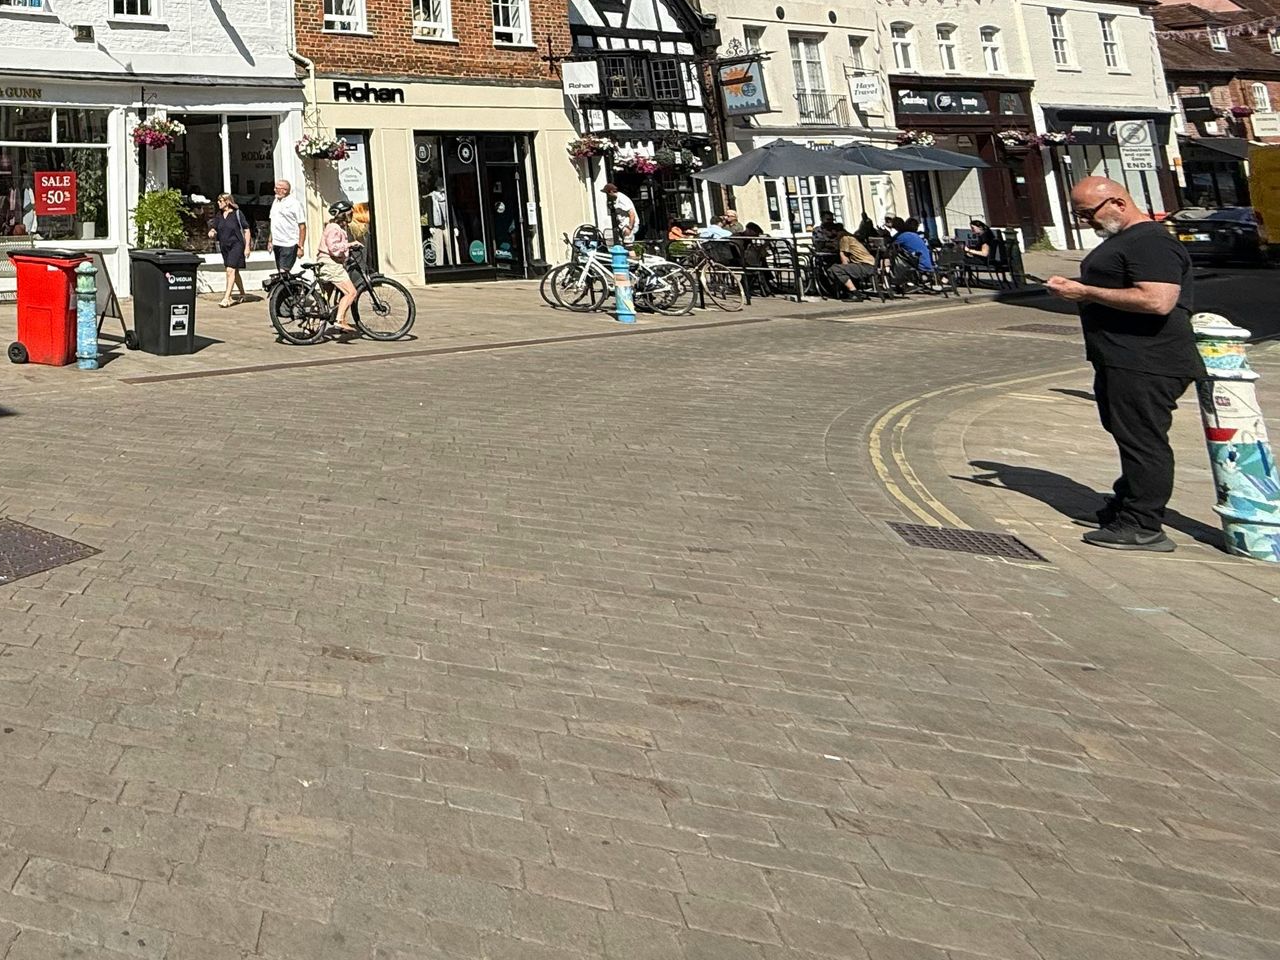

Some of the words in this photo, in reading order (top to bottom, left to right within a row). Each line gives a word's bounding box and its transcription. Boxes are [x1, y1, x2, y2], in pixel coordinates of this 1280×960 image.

[5, 86, 42, 98] GUNN
[333, 81, 405, 103] Rohan
[854, 88, 878, 96] Travel
[41, 176, 71, 187] SALE
